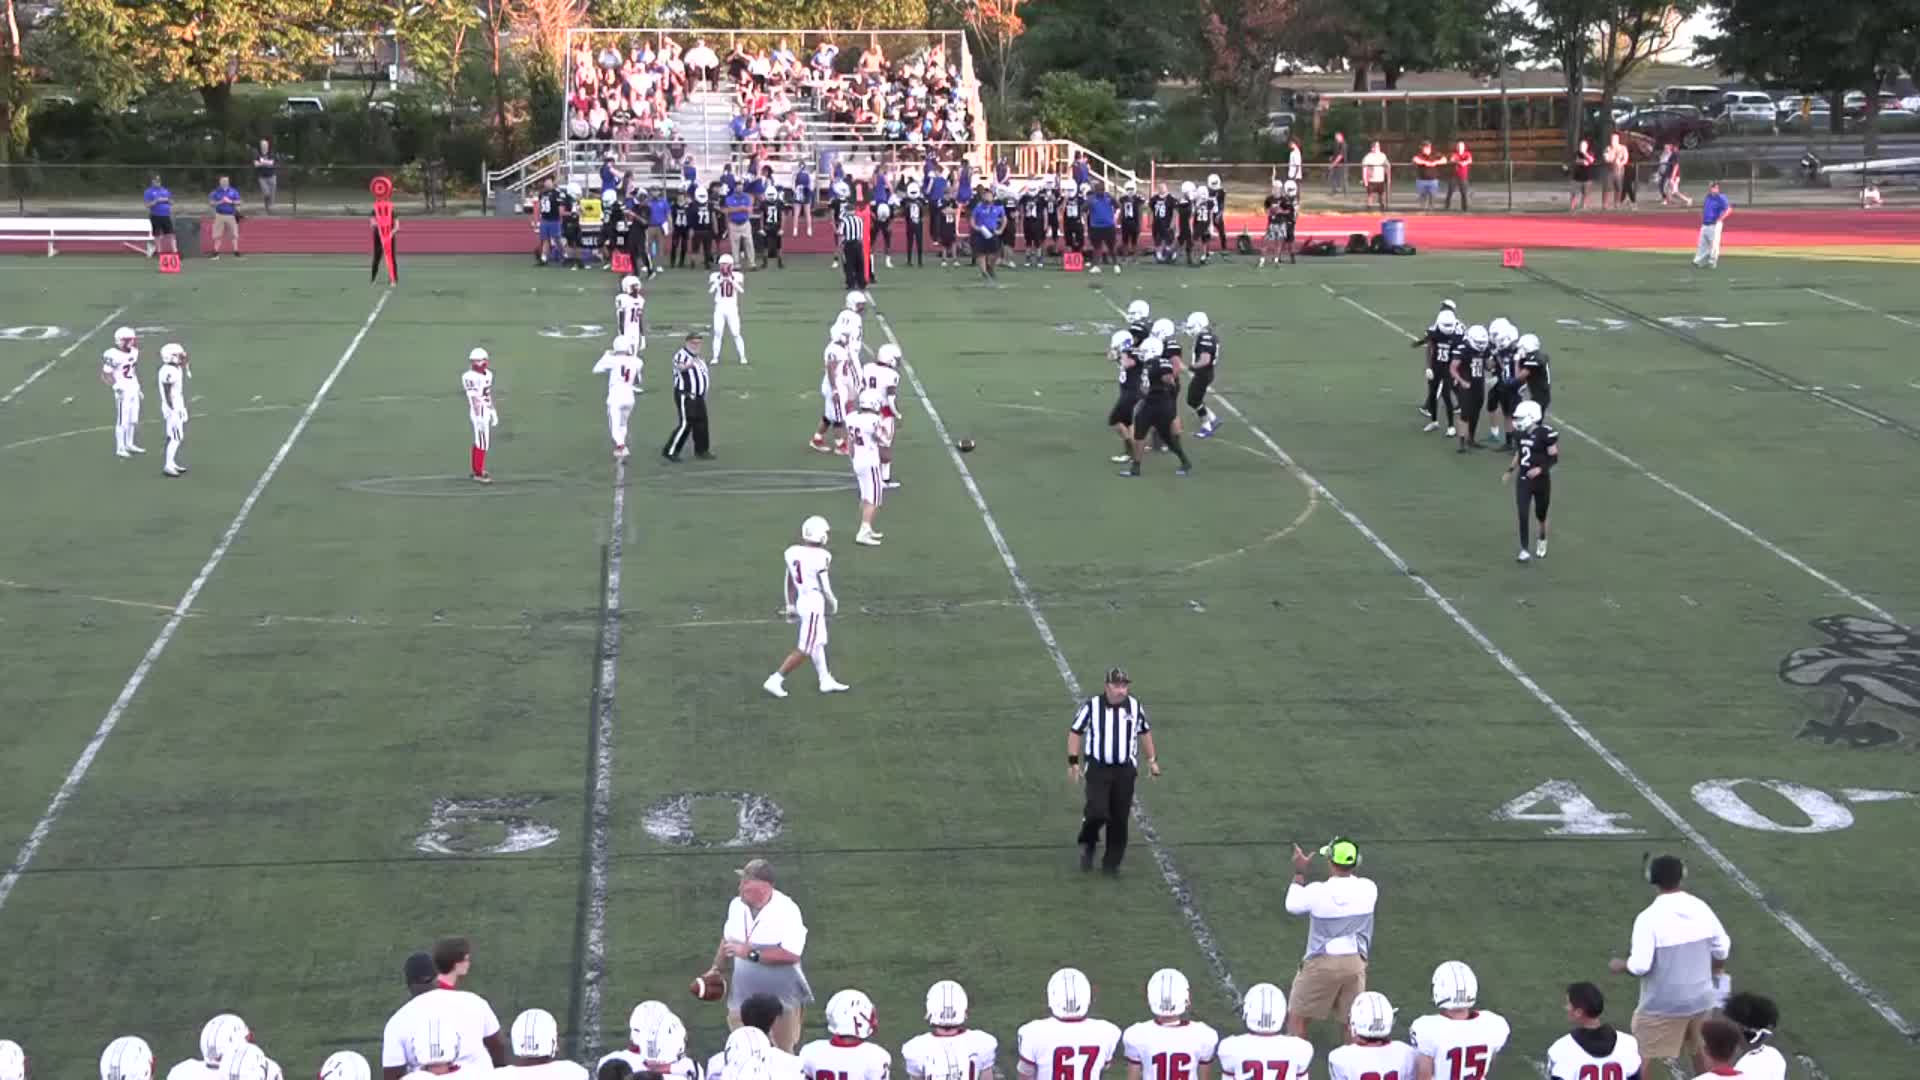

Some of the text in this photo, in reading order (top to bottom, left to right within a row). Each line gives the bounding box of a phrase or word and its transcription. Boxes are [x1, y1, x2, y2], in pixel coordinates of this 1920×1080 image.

[766, 205, 779, 223] 21
[161, 254, 178, 269] 40
[1066, 253, 1082, 267] 40
[720, 280, 734, 298] 10
[620, 364, 631, 383] 4
[1520, 446, 1531, 467] 2
[1488, 777, 1856, 835] 40
[1053, 1045, 1101, 1080] 67
[1152, 1052, 1192, 1080] 16
[1446, 1045, 1489, 1080] 15
